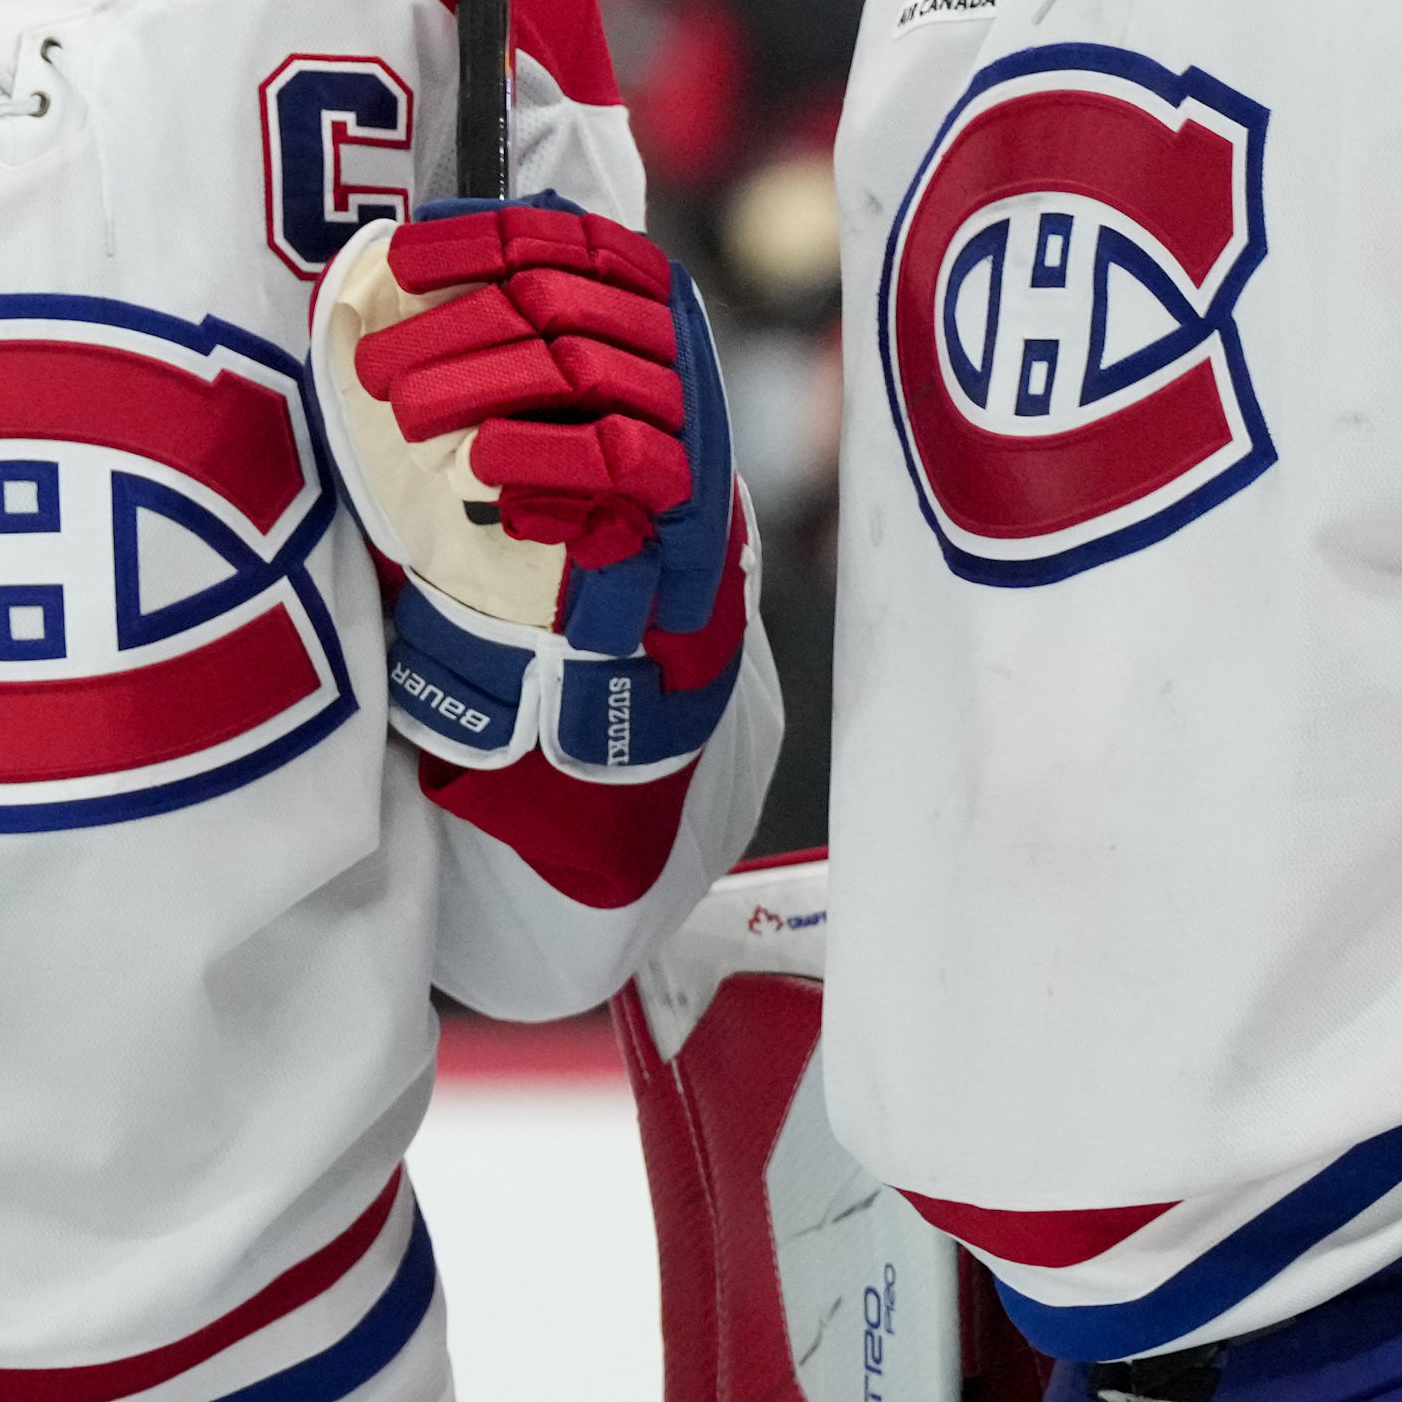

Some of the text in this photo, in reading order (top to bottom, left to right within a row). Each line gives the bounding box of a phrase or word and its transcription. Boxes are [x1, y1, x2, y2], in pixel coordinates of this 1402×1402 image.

[258, 53, 415, 281] C
[391, 661, 491, 734] BAUER
[607, 677, 631, 766] SUZUKI
